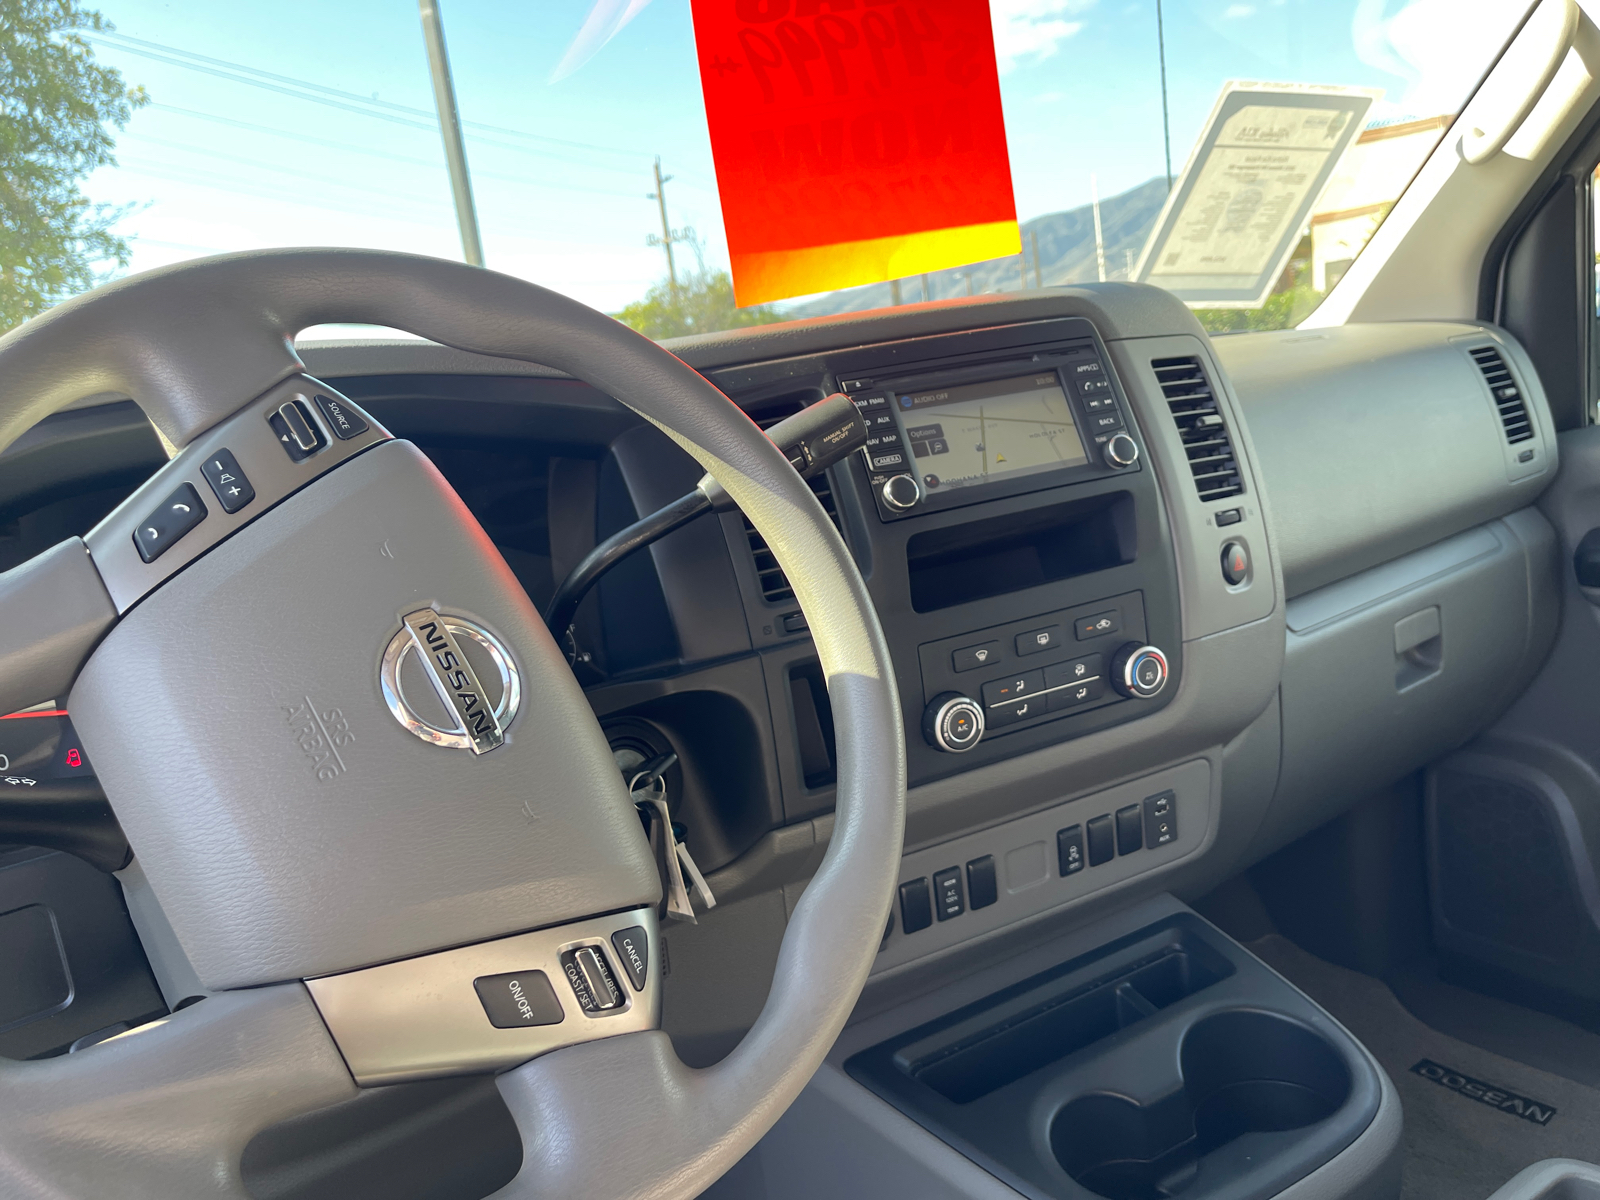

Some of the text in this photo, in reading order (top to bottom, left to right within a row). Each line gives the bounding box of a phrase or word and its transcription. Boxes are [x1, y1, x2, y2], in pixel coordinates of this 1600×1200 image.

[914, 395, 935, 404] AUDIO
[327, 401, 351, 430] SOURCE
[877, 416, 890, 424] AUX
[1099, 417, 1114, 425] BACK
[823, 421, 854, 443] MANUAL SHIFT
[882, 435, 897, 443] MAP
[911, 429, 937, 438] Options
[875, 454, 901, 466] CAMERA
[419, 621, 492, 736] NISSAN
[322, 708, 356, 747] SRS
[281, 704, 339, 781] AIRBAG
[623, 938, 646, 974] CANCEL
[564, 963, 594, 1010] COAST/SET
[508, 980, 534, 1020] ON/OFF
